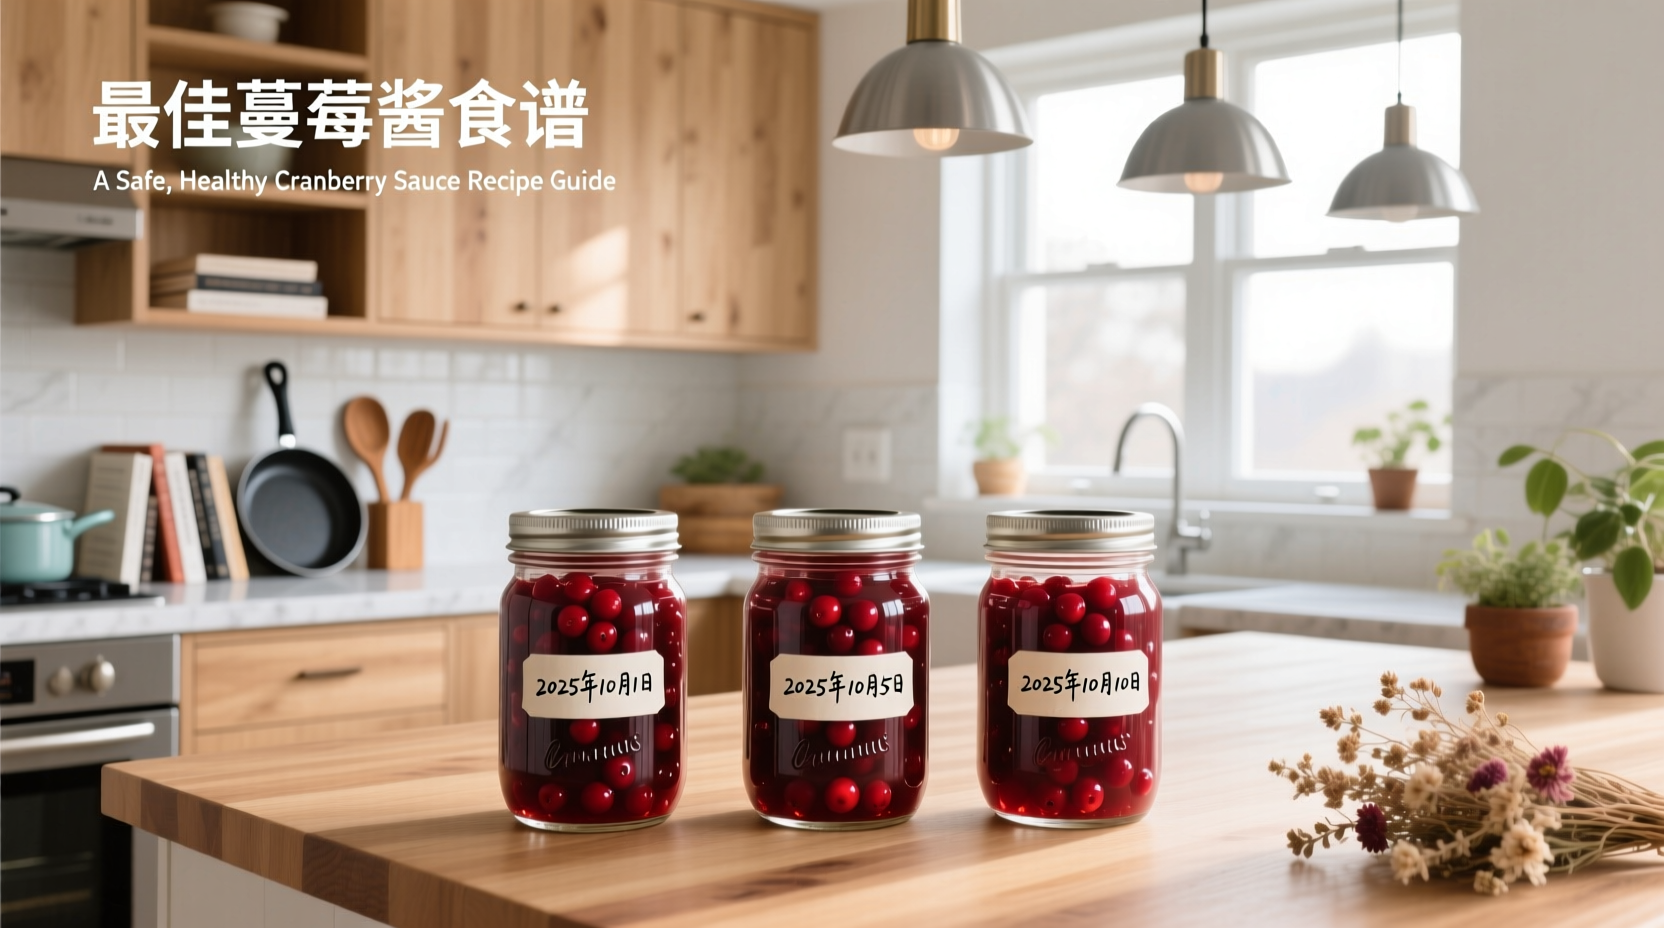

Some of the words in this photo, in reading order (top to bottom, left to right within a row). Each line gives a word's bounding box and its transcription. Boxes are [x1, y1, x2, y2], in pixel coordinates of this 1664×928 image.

[536, 669, 652, 703] 2025年10月1日
[783, 670, 903, 703] 2025年10月5日
[1020, 668, 1140, 702] 2025年10月10日
